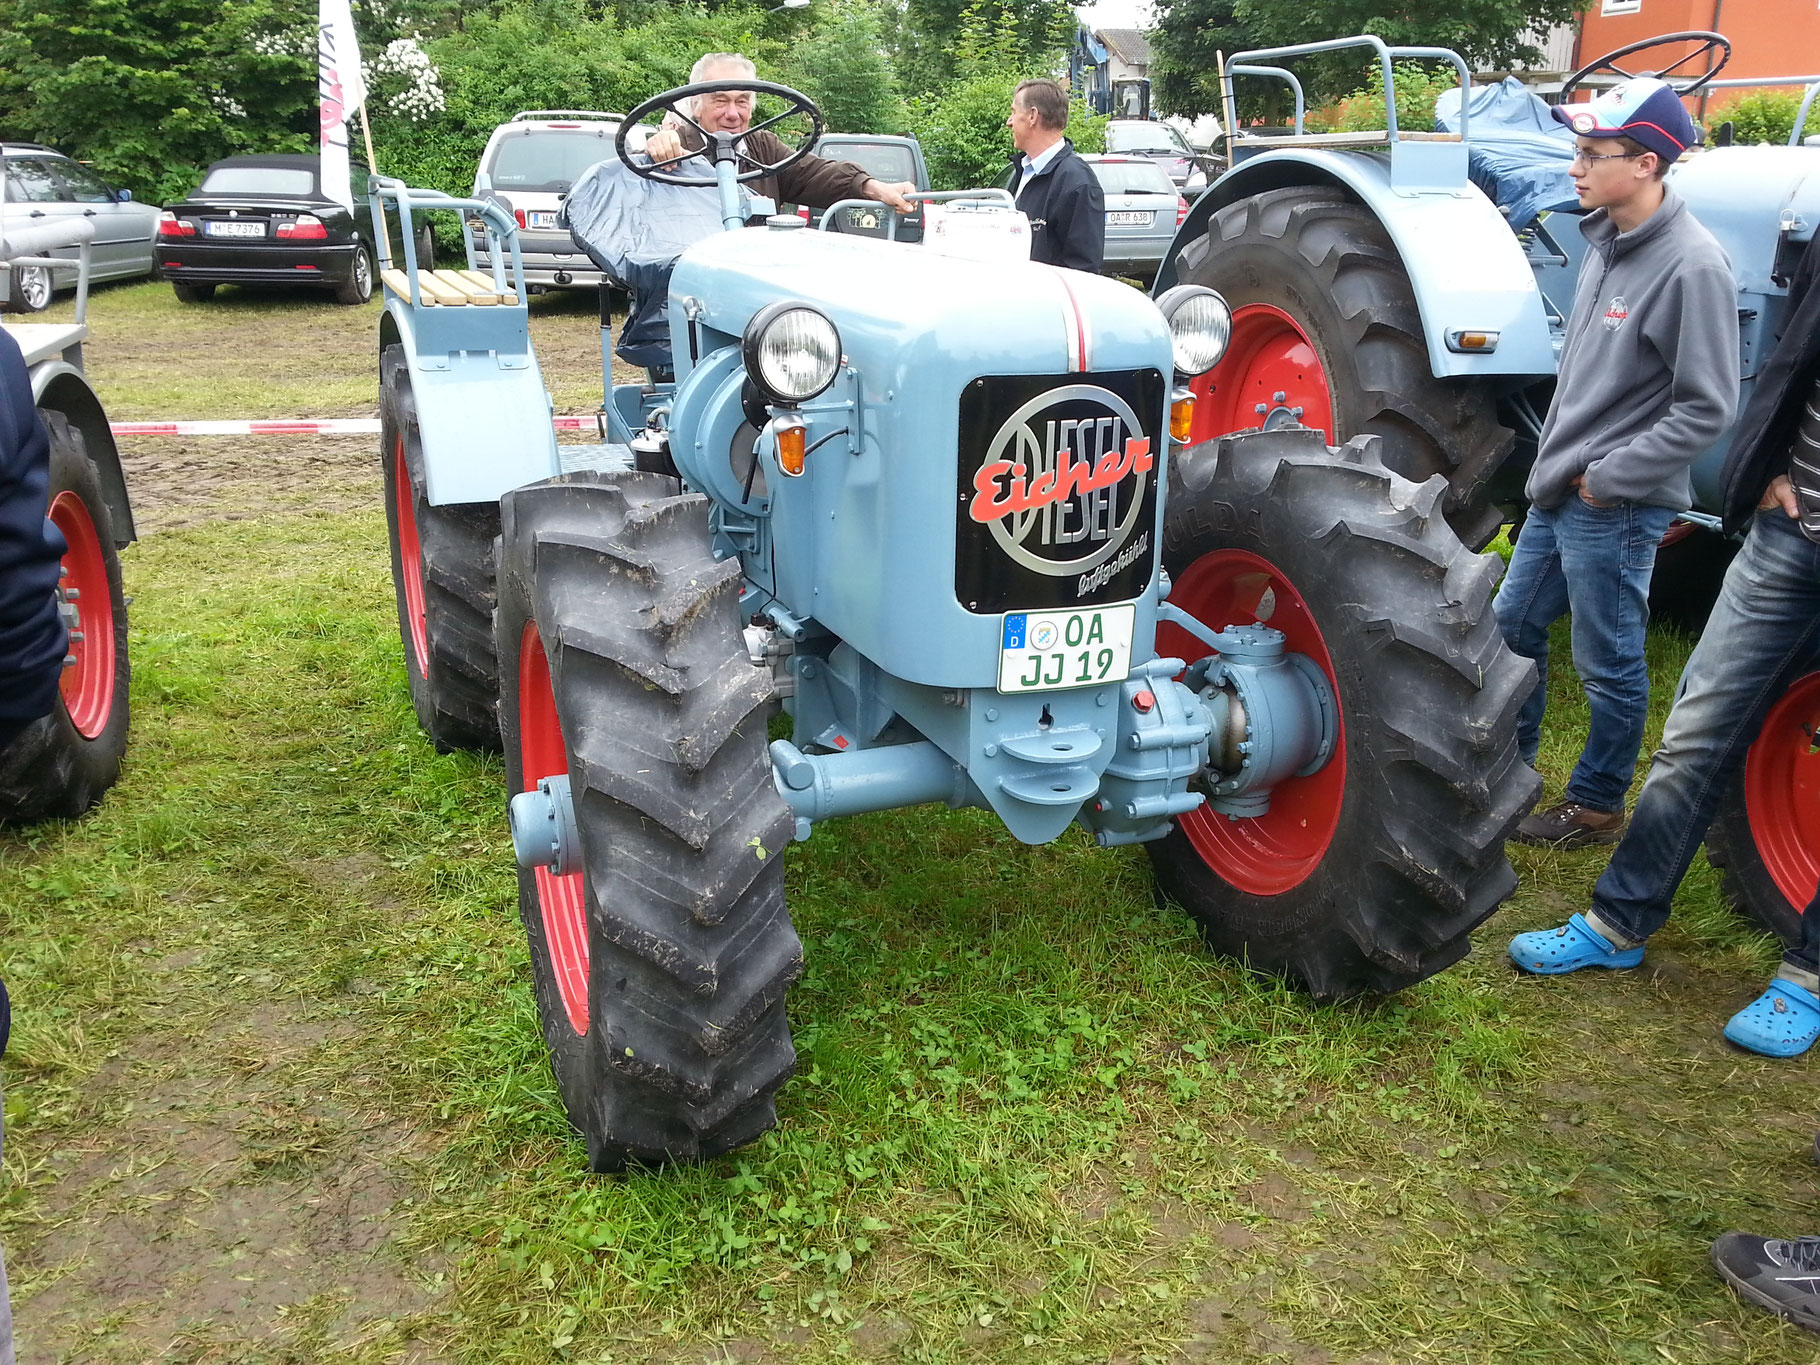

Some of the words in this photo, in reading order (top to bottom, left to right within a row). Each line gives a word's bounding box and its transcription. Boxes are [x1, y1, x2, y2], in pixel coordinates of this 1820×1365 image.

[236, 223, 260, 234] 7376
[1133, 213, 1148, 222] 638
[969, 436, 1153, 523] Eicher
[1163, 500, 1269, 552] ULDA
[1010, 636, 1019, 647] D
[1065, 613, 1103, 647] OA
[1020, 653, 1064, 686] JJ
[1075, 648, 1113, 682] 19
